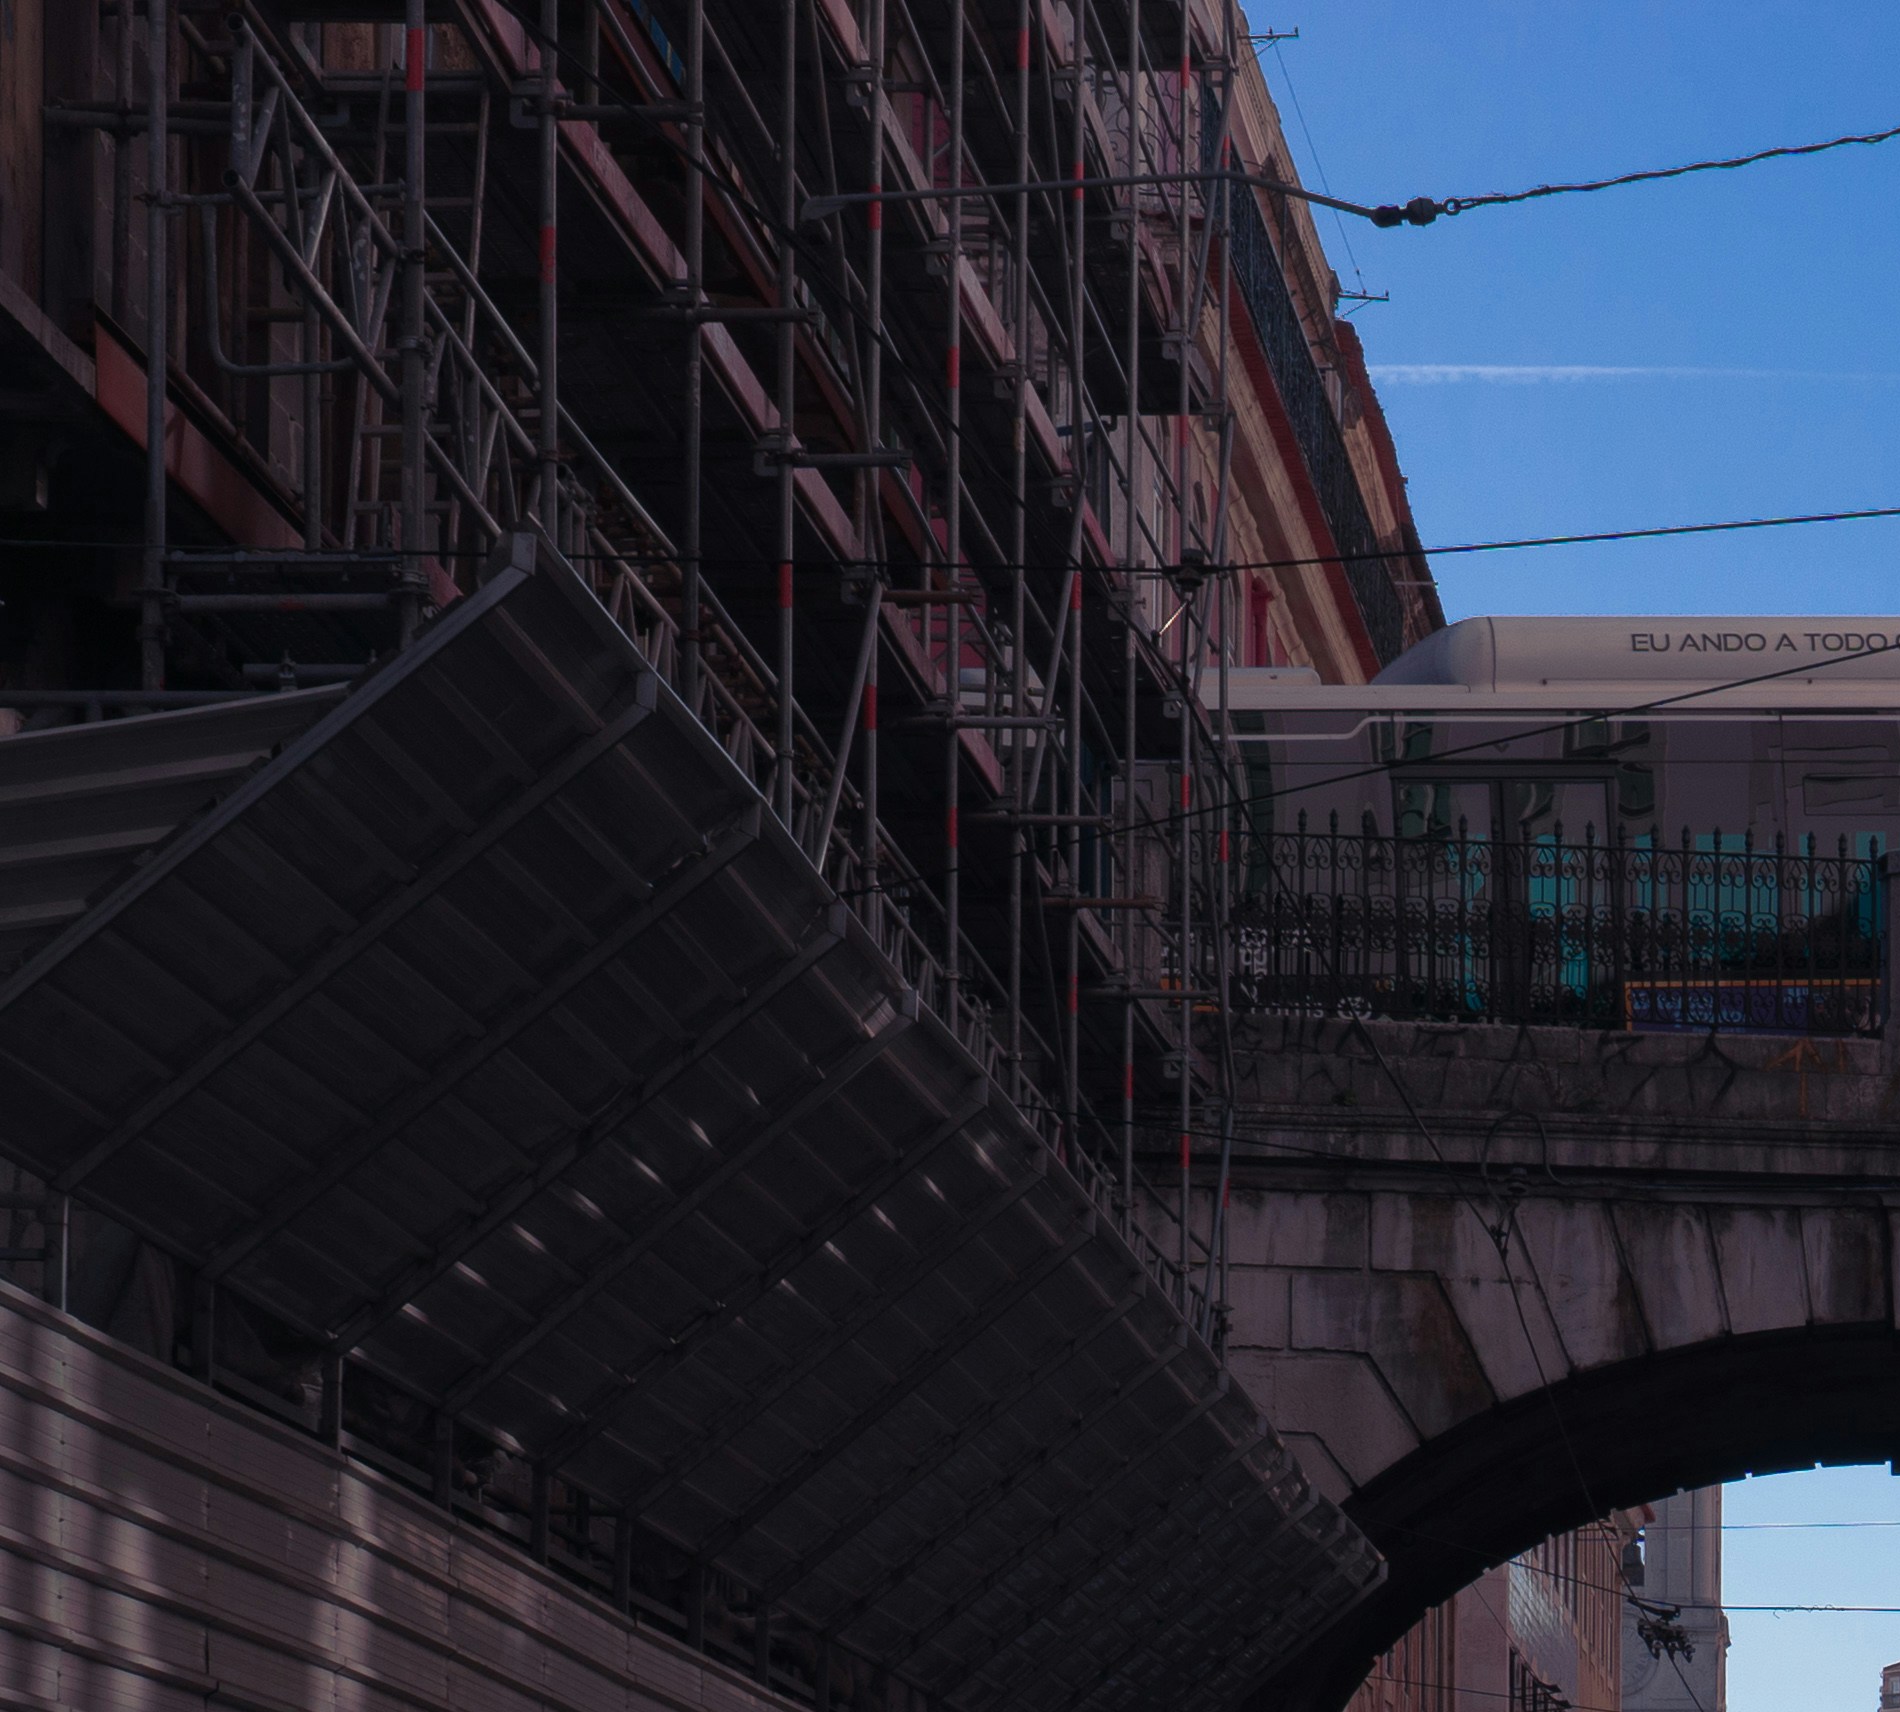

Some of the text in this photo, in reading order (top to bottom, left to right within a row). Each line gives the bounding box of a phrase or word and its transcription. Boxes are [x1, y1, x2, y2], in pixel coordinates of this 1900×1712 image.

[1631, 633, 1671, 652] EU
[1679, 633, 1767, 652] ANDO
[1775, 633, 1798, 652] A
[1799, 633, 1889, 652] TODO
